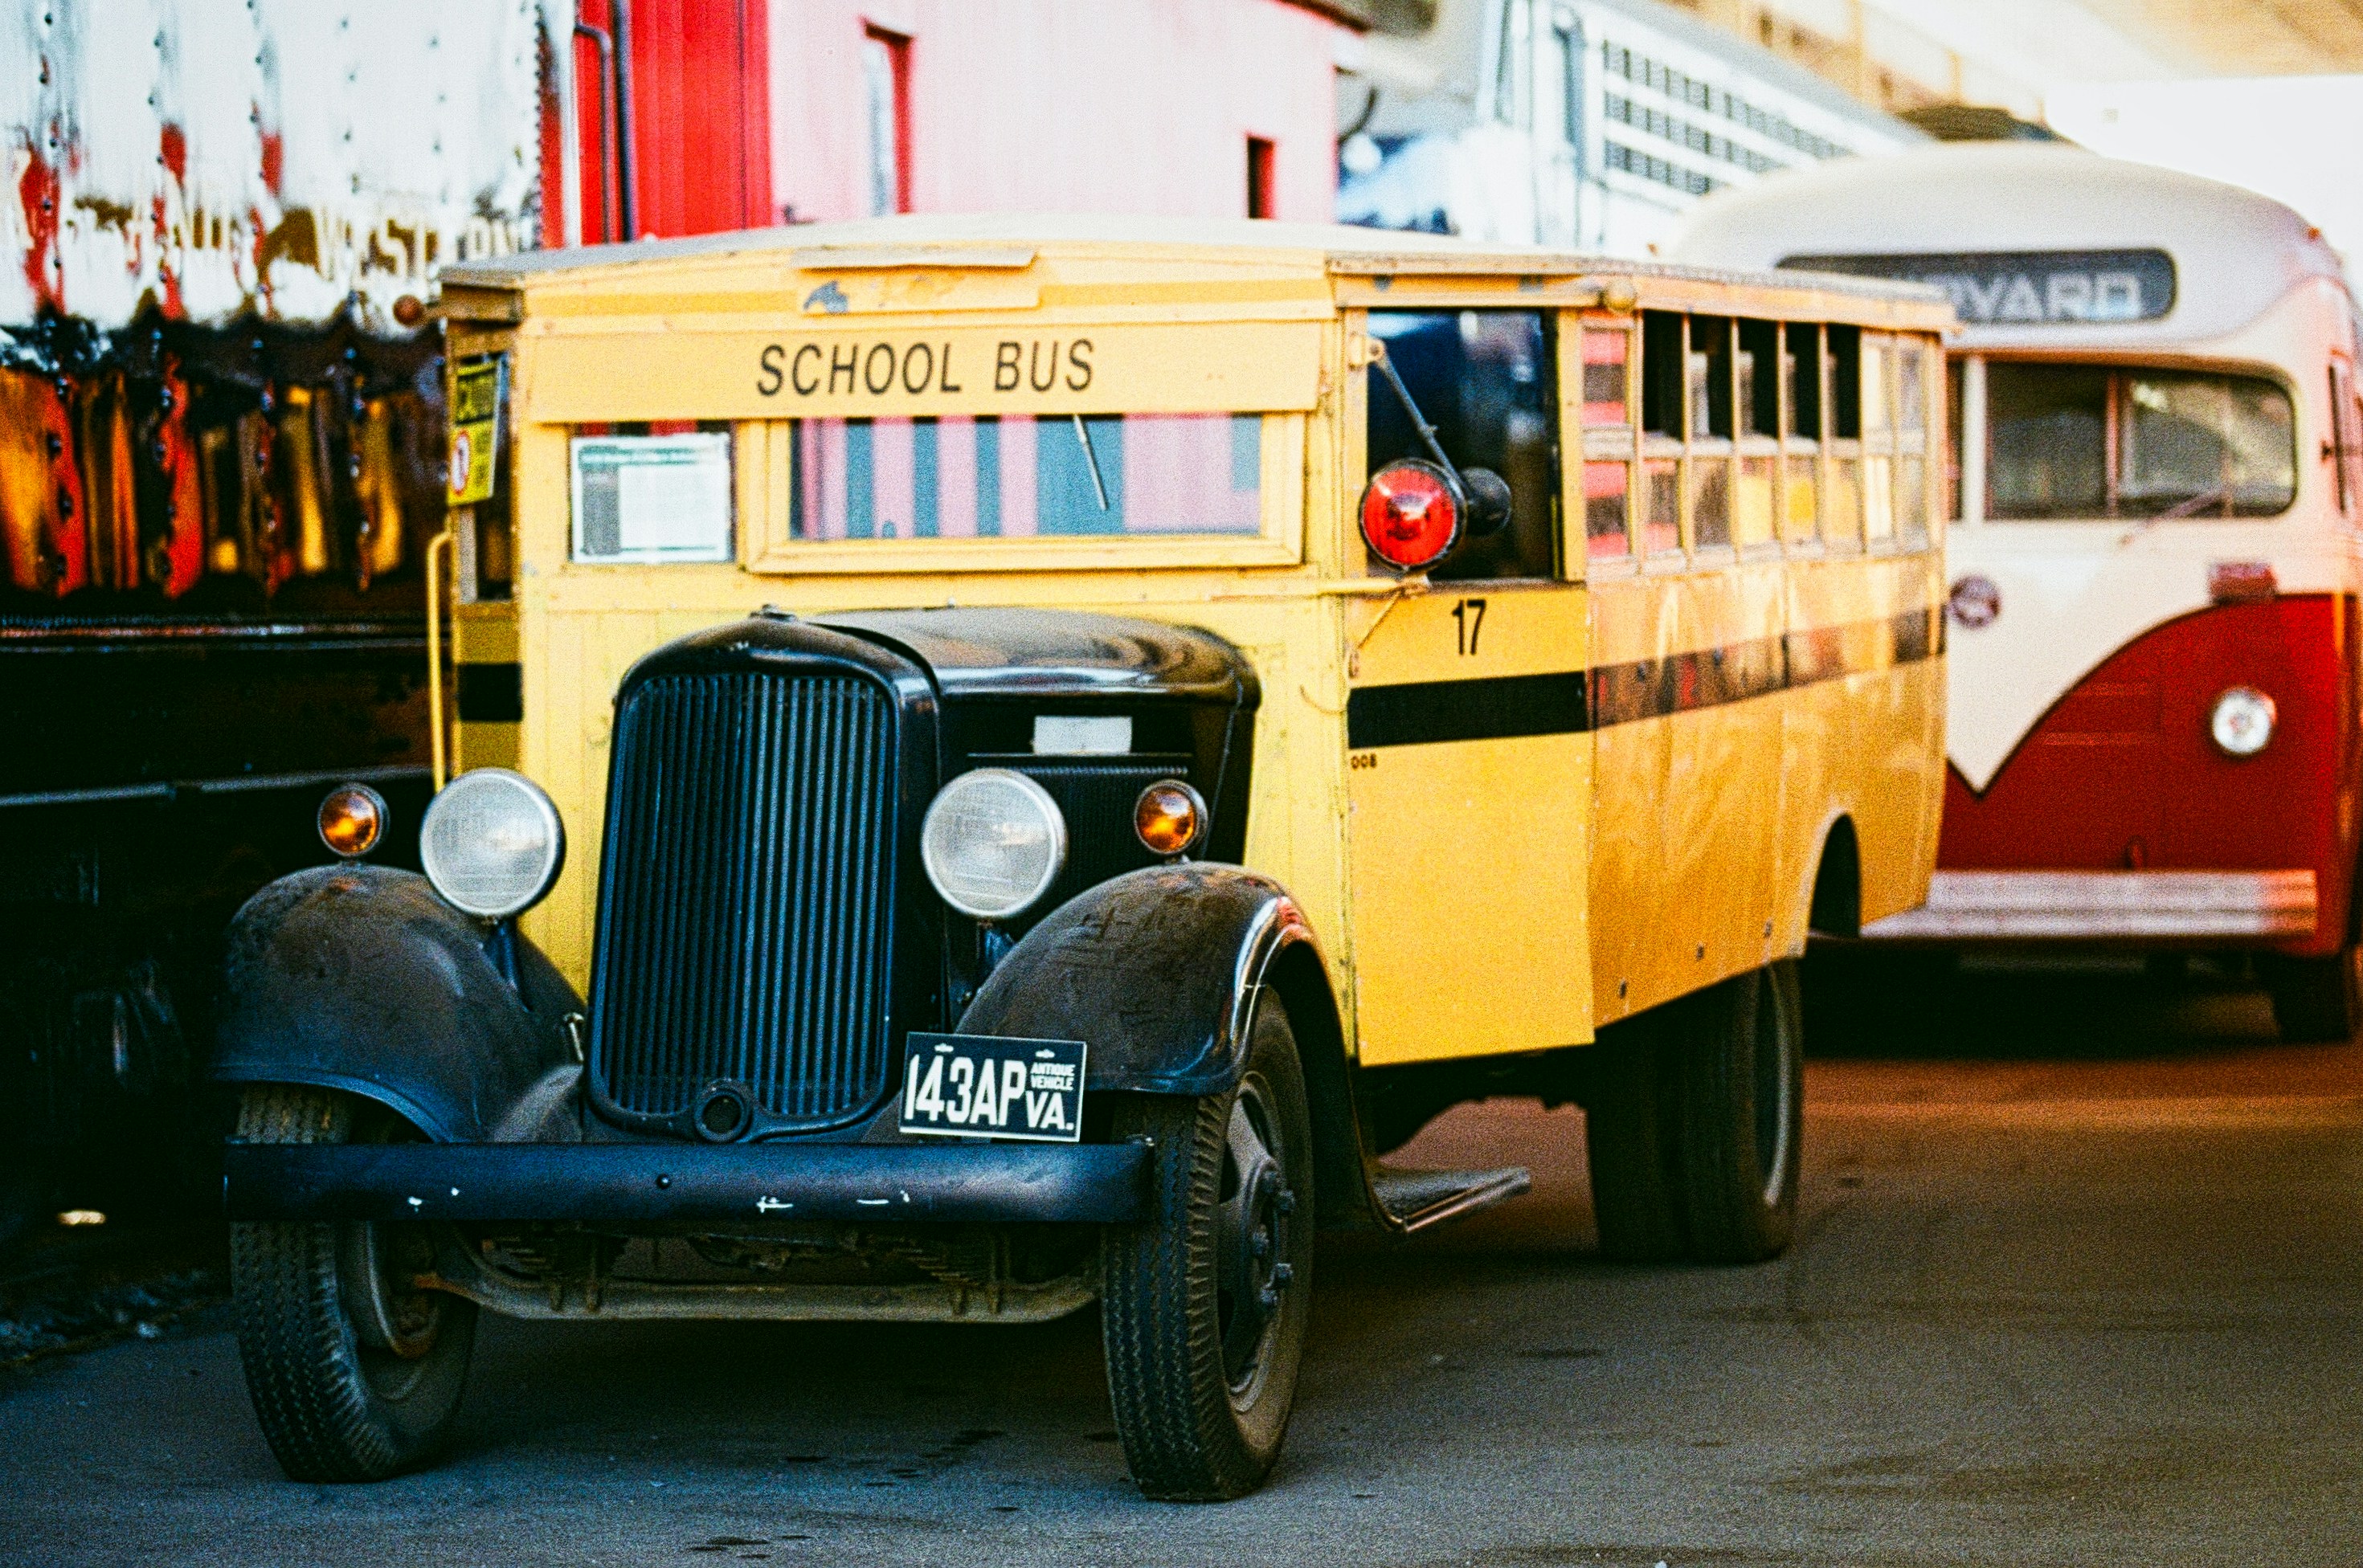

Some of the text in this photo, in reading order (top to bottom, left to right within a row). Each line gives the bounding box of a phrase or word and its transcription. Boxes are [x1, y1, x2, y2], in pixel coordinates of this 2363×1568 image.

[757, 338, 1094, 396] SCHOOL BUS
[1452, 599, 1486, 655] 17
[904, 1054, 1027, 1126] 143AP
[1030, 1062, 1076, 1076] ANTIQUE
[1030, 1075, 1074, 1090] VEHICLE
[1025, 1090, 1075, 1130] VA.
